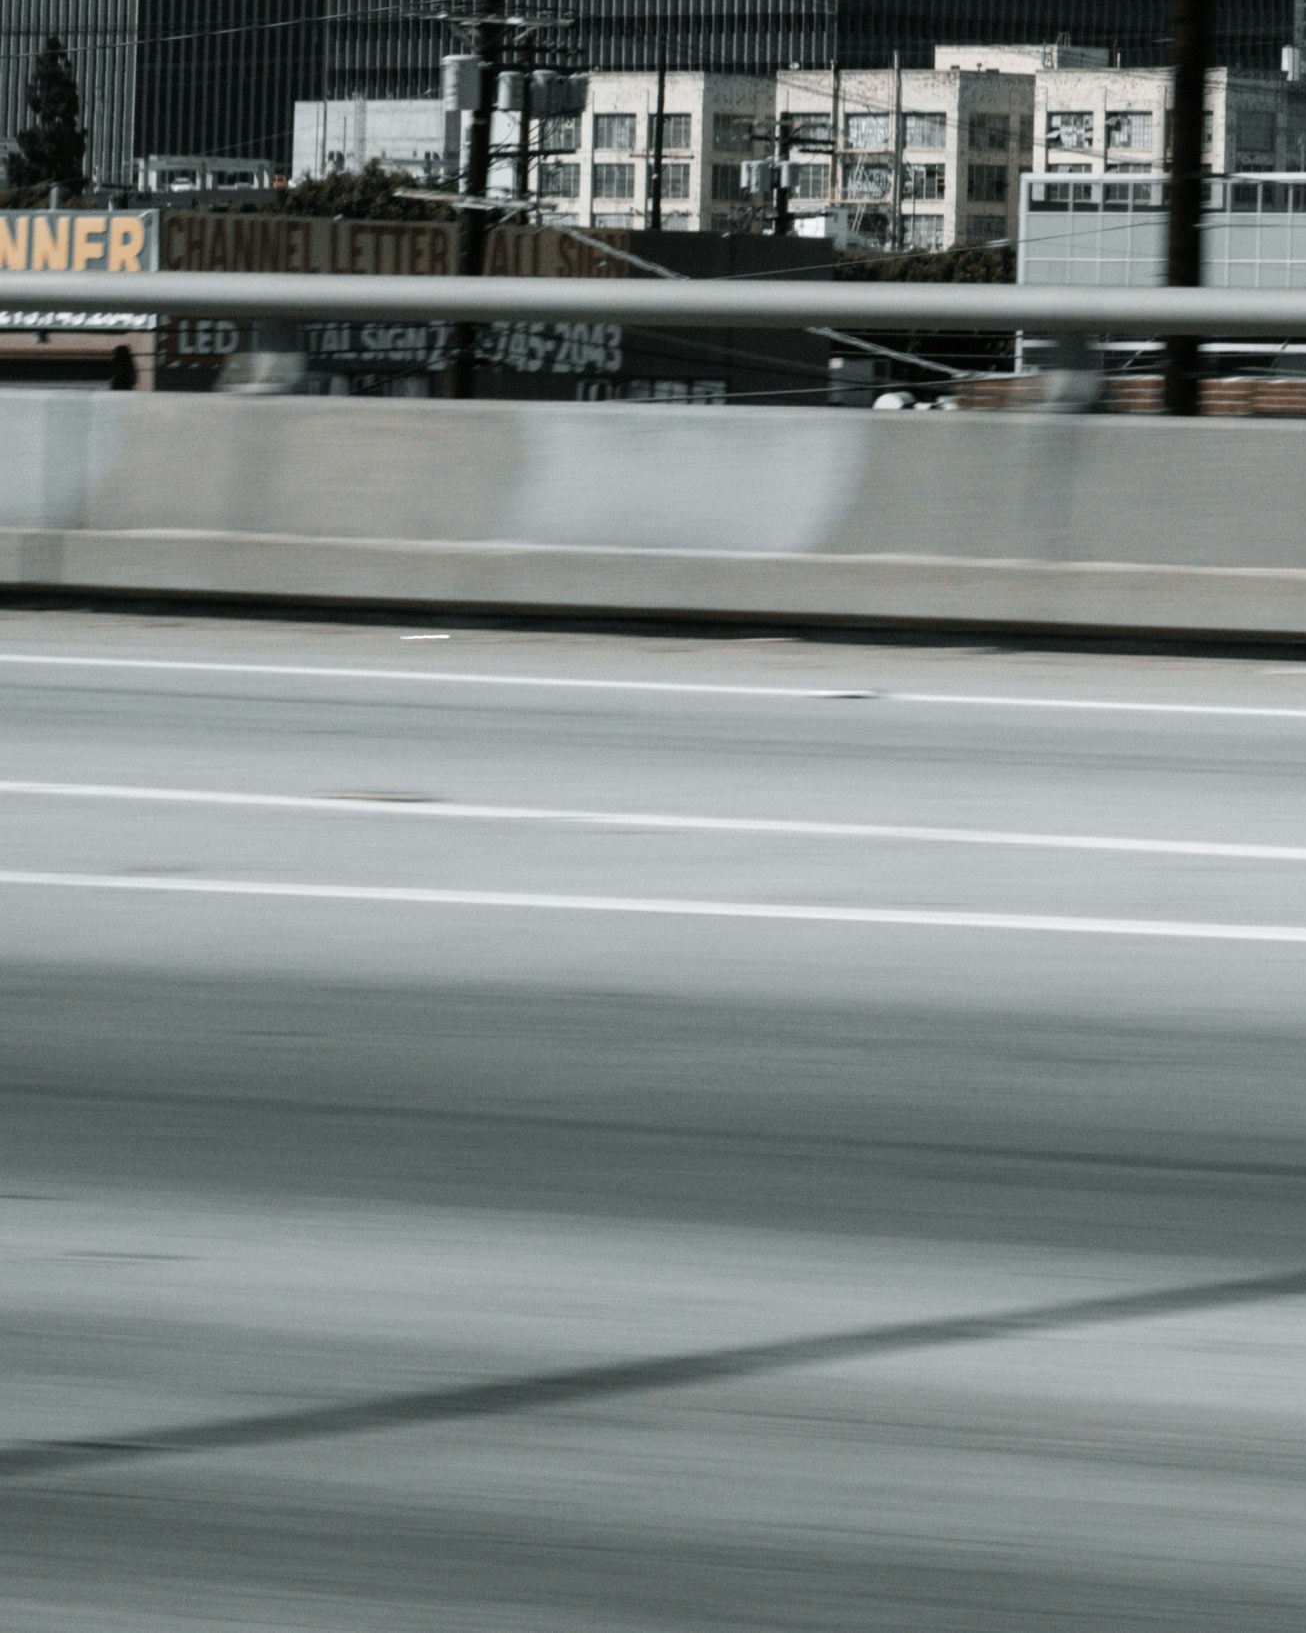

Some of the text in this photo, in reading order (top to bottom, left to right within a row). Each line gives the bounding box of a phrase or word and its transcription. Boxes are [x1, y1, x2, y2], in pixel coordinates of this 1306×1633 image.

[166, 216, 450, 275] CHANNEL LETTER
[177, 320, 239, 354] LED
